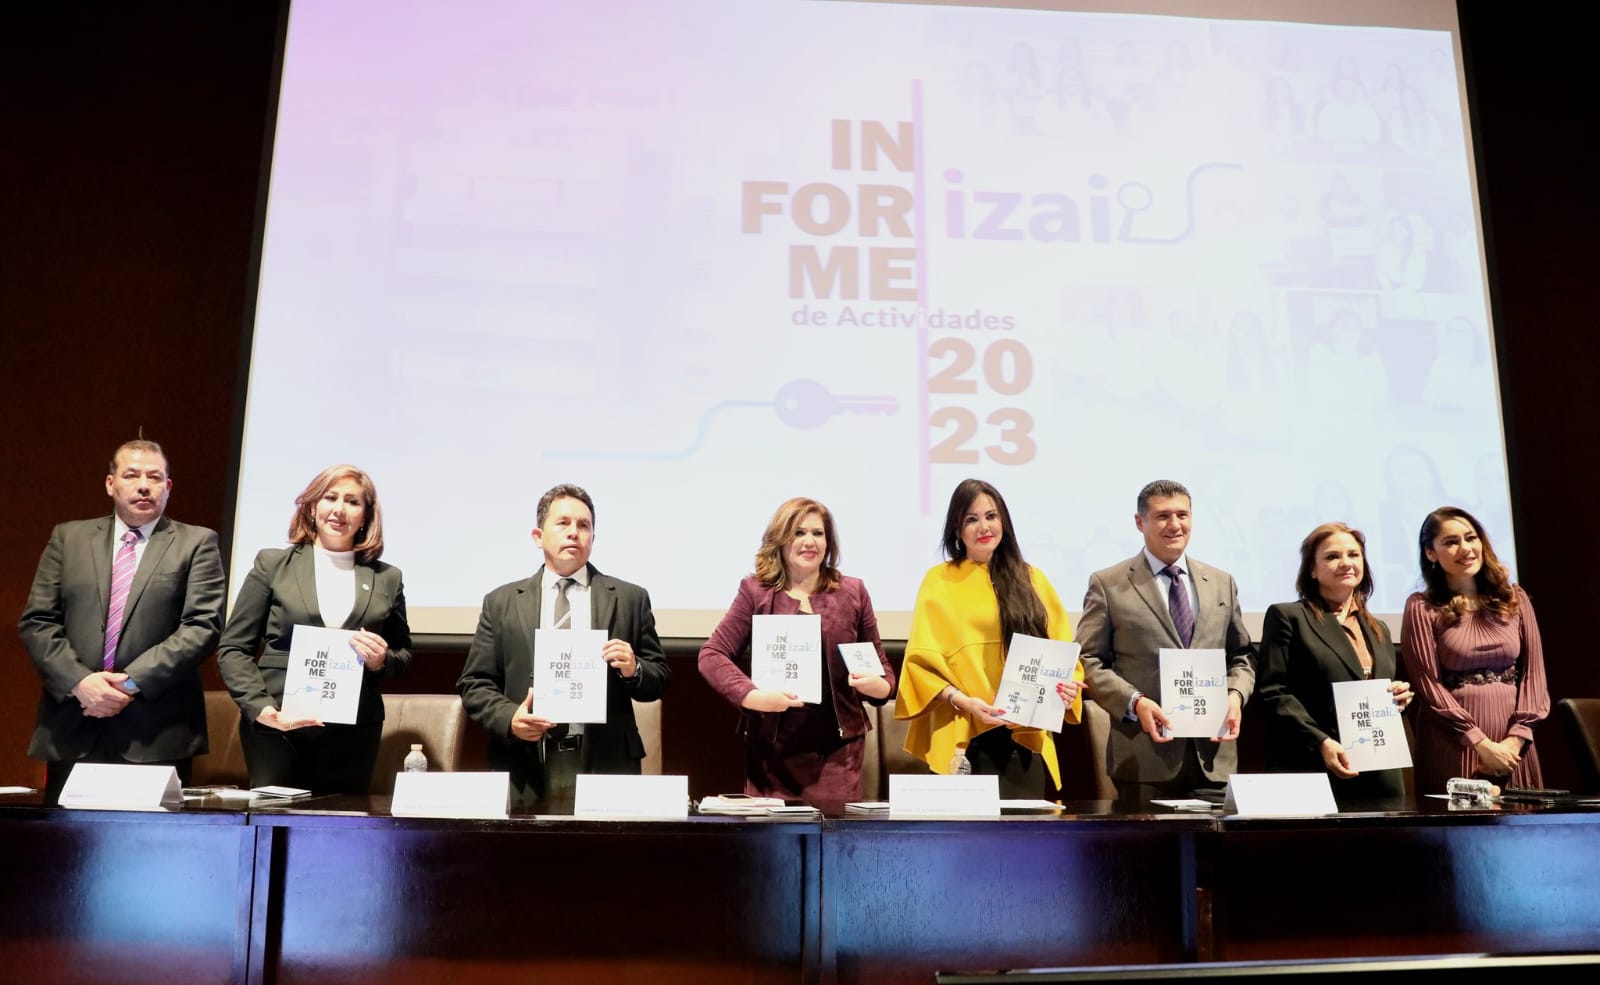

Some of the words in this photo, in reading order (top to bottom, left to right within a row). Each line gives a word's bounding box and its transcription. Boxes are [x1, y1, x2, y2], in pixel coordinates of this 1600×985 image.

[831, 119, 915, 172] IN
[741, 181, 915, 238] FOR
[943, 168, 1112, 243] izai
[788, 244, 918, 301] ME
[791, 304, 827, 326] de
[836, 305, 1016, 331] Actividades
[927, 336, 1034, 397] 20
[927, 405, 1038, 466] 23
[776, 635, 787, 643] IN
[317, 650, 328, 659] IN
[560, 652, 572, 660] IN
[304, 659, 326, 668] FOR
[550, 662, 570, 670] FOR
[1030, 658, 1041, 666] IN
[785, 663, 798, 671] 20
[1018, 665, 1039, 674] FOR
[309, 668, 326, 677] ME
[555, 670, 571, 678] ME
[785, 671, 798, 679] 23
[1183, 670, 1193, 678] IN
[1021, 673, 1037, 682] ME
[323, 681, 336, 690] 20
[570, 682, 583, 690] 20
[1174, 679, 1193, 687] FOR
[321, 690, 336, 699] 23
[570, 691, 583, 699] 23
[1194, 699, 1206, 707] 20
[1359, 702, 1369, 710] IN
[1194, 707, 1207, 715] 23
[1351, 711, 1370, 720] FOR
[1357, 719, 1372, 728] ME
[1372, 730, 1384, 738] 20
[1374, 738, 1386, 746] 23
